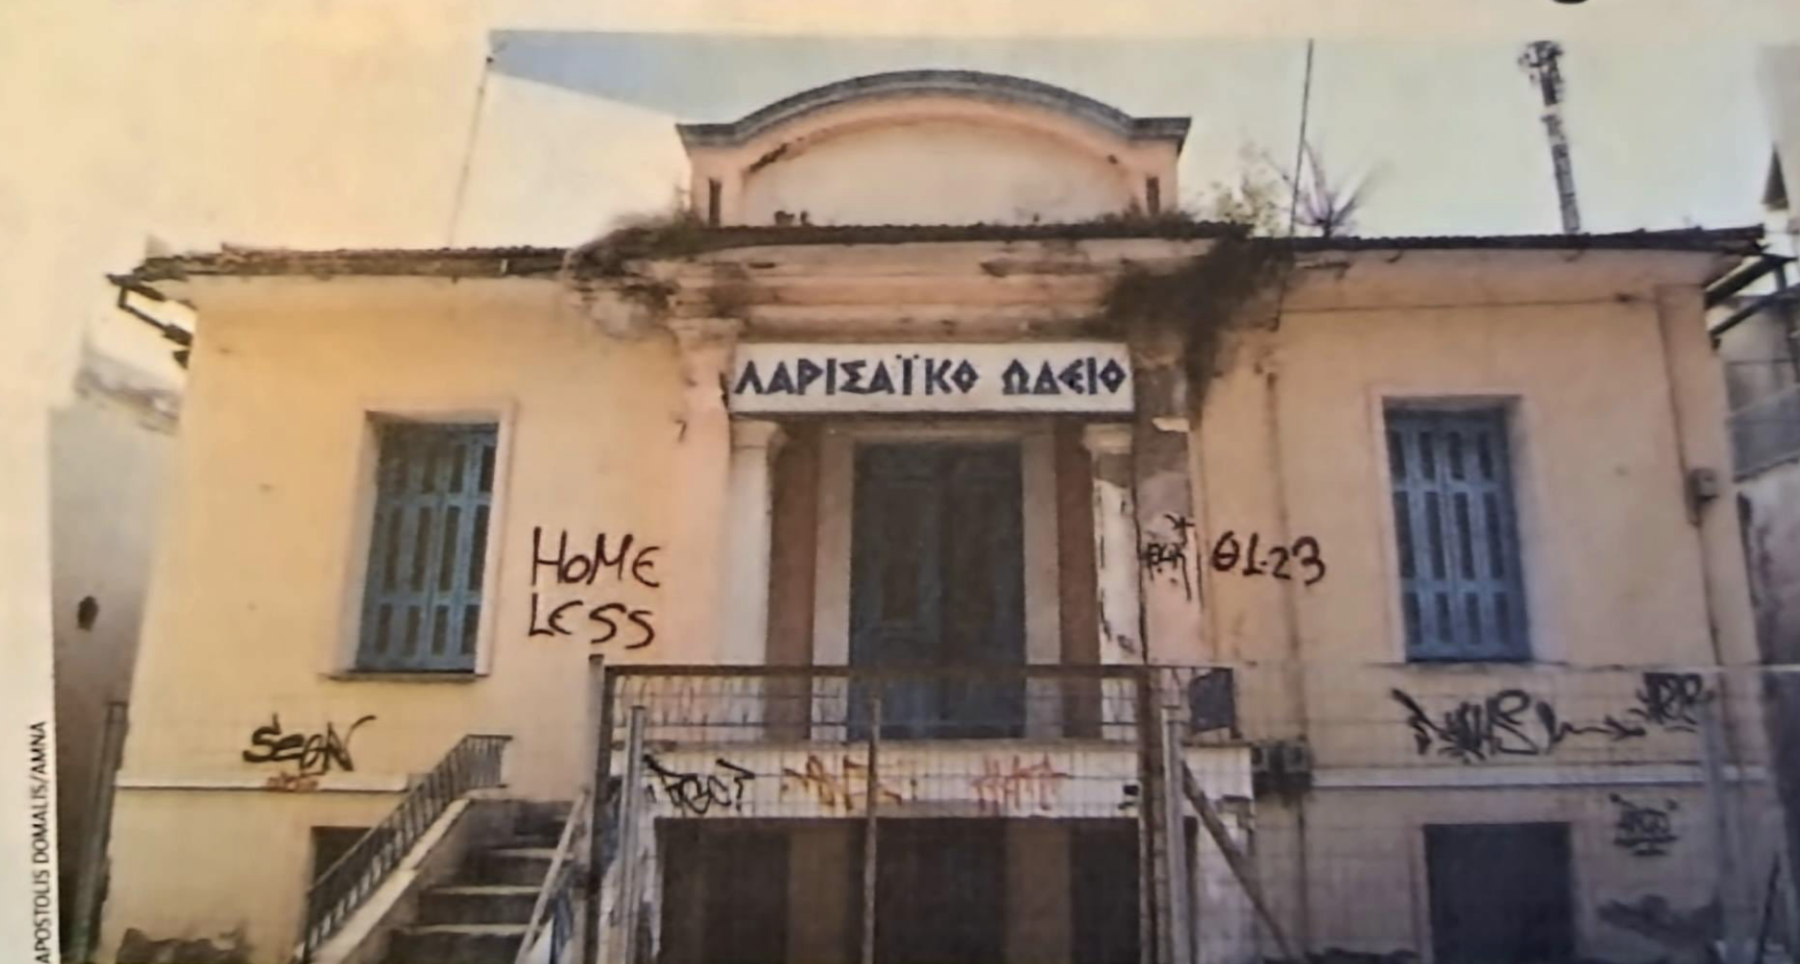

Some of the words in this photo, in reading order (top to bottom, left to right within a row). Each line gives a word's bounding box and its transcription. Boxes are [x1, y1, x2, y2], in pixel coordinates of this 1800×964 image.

[734, 354, 980, 396] ΛΑΡΙΣΑΪΚΟ
[1001, 356, 1128, 396] ΩΔΕΙΟ
[528, 592, 655, 650] LESS
